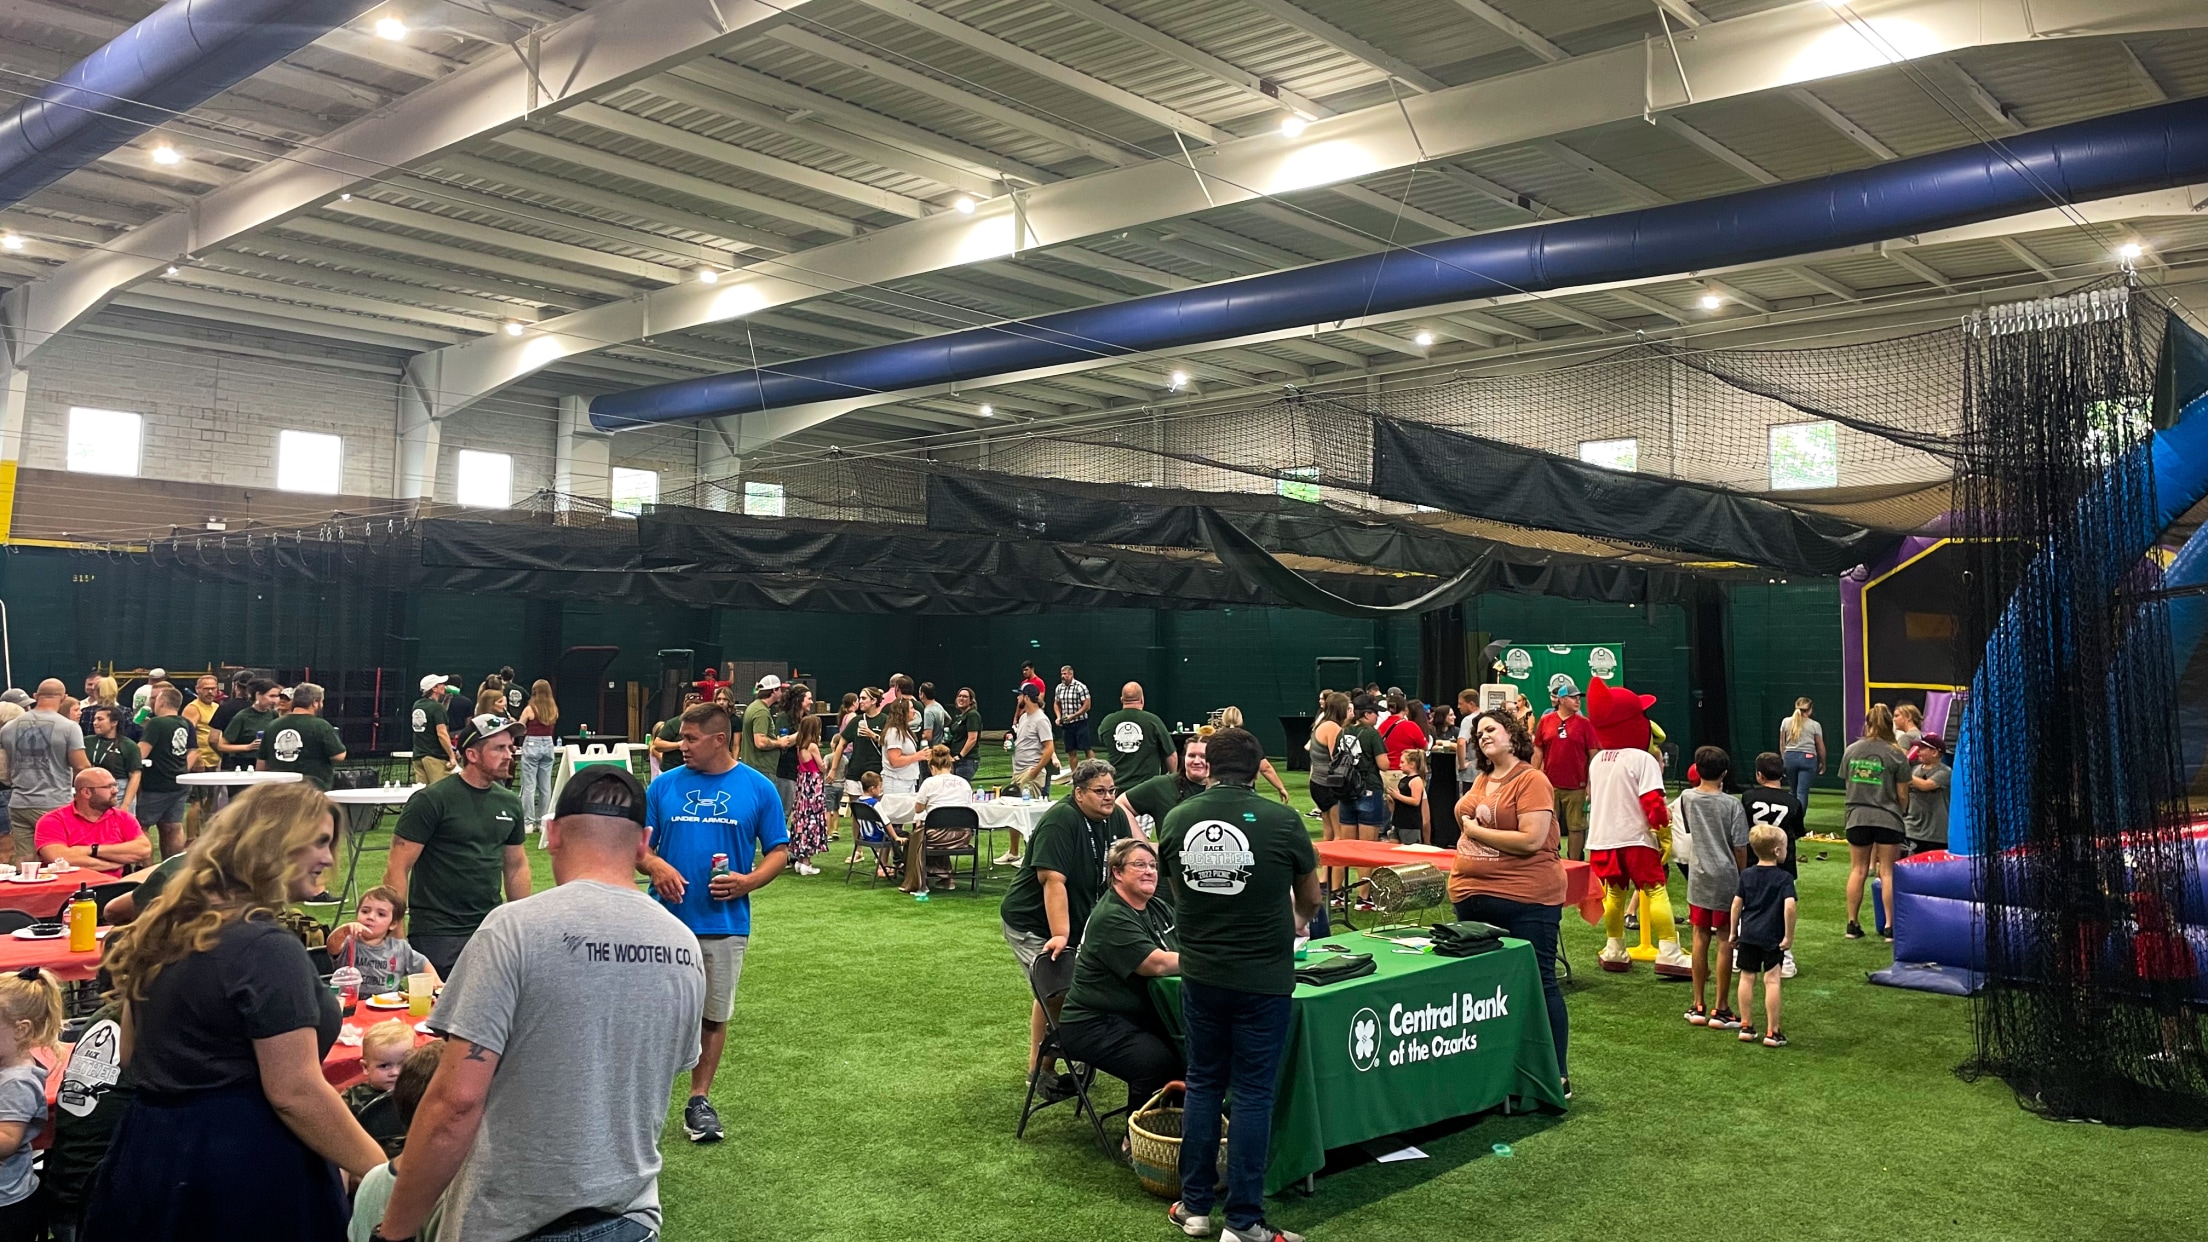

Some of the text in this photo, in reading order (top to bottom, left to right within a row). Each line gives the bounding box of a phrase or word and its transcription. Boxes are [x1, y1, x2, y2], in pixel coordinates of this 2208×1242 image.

[671, 815, 738, 825] UNDER ARMOUR
[1751, 801, 1789, 827] 27
[1180, 851, 1254, 865] TOGETHER
[1198, 870, 1212, 879] 2022
[586, 942, 610, 961] THE
[614, 943, 672, 964] WOOTEN
[676, 947, 694, 967] CO.
[1389, 984, 1509, 1037] Central Bank
[1389, 1028, 1477, 1066] of the Ozarks
